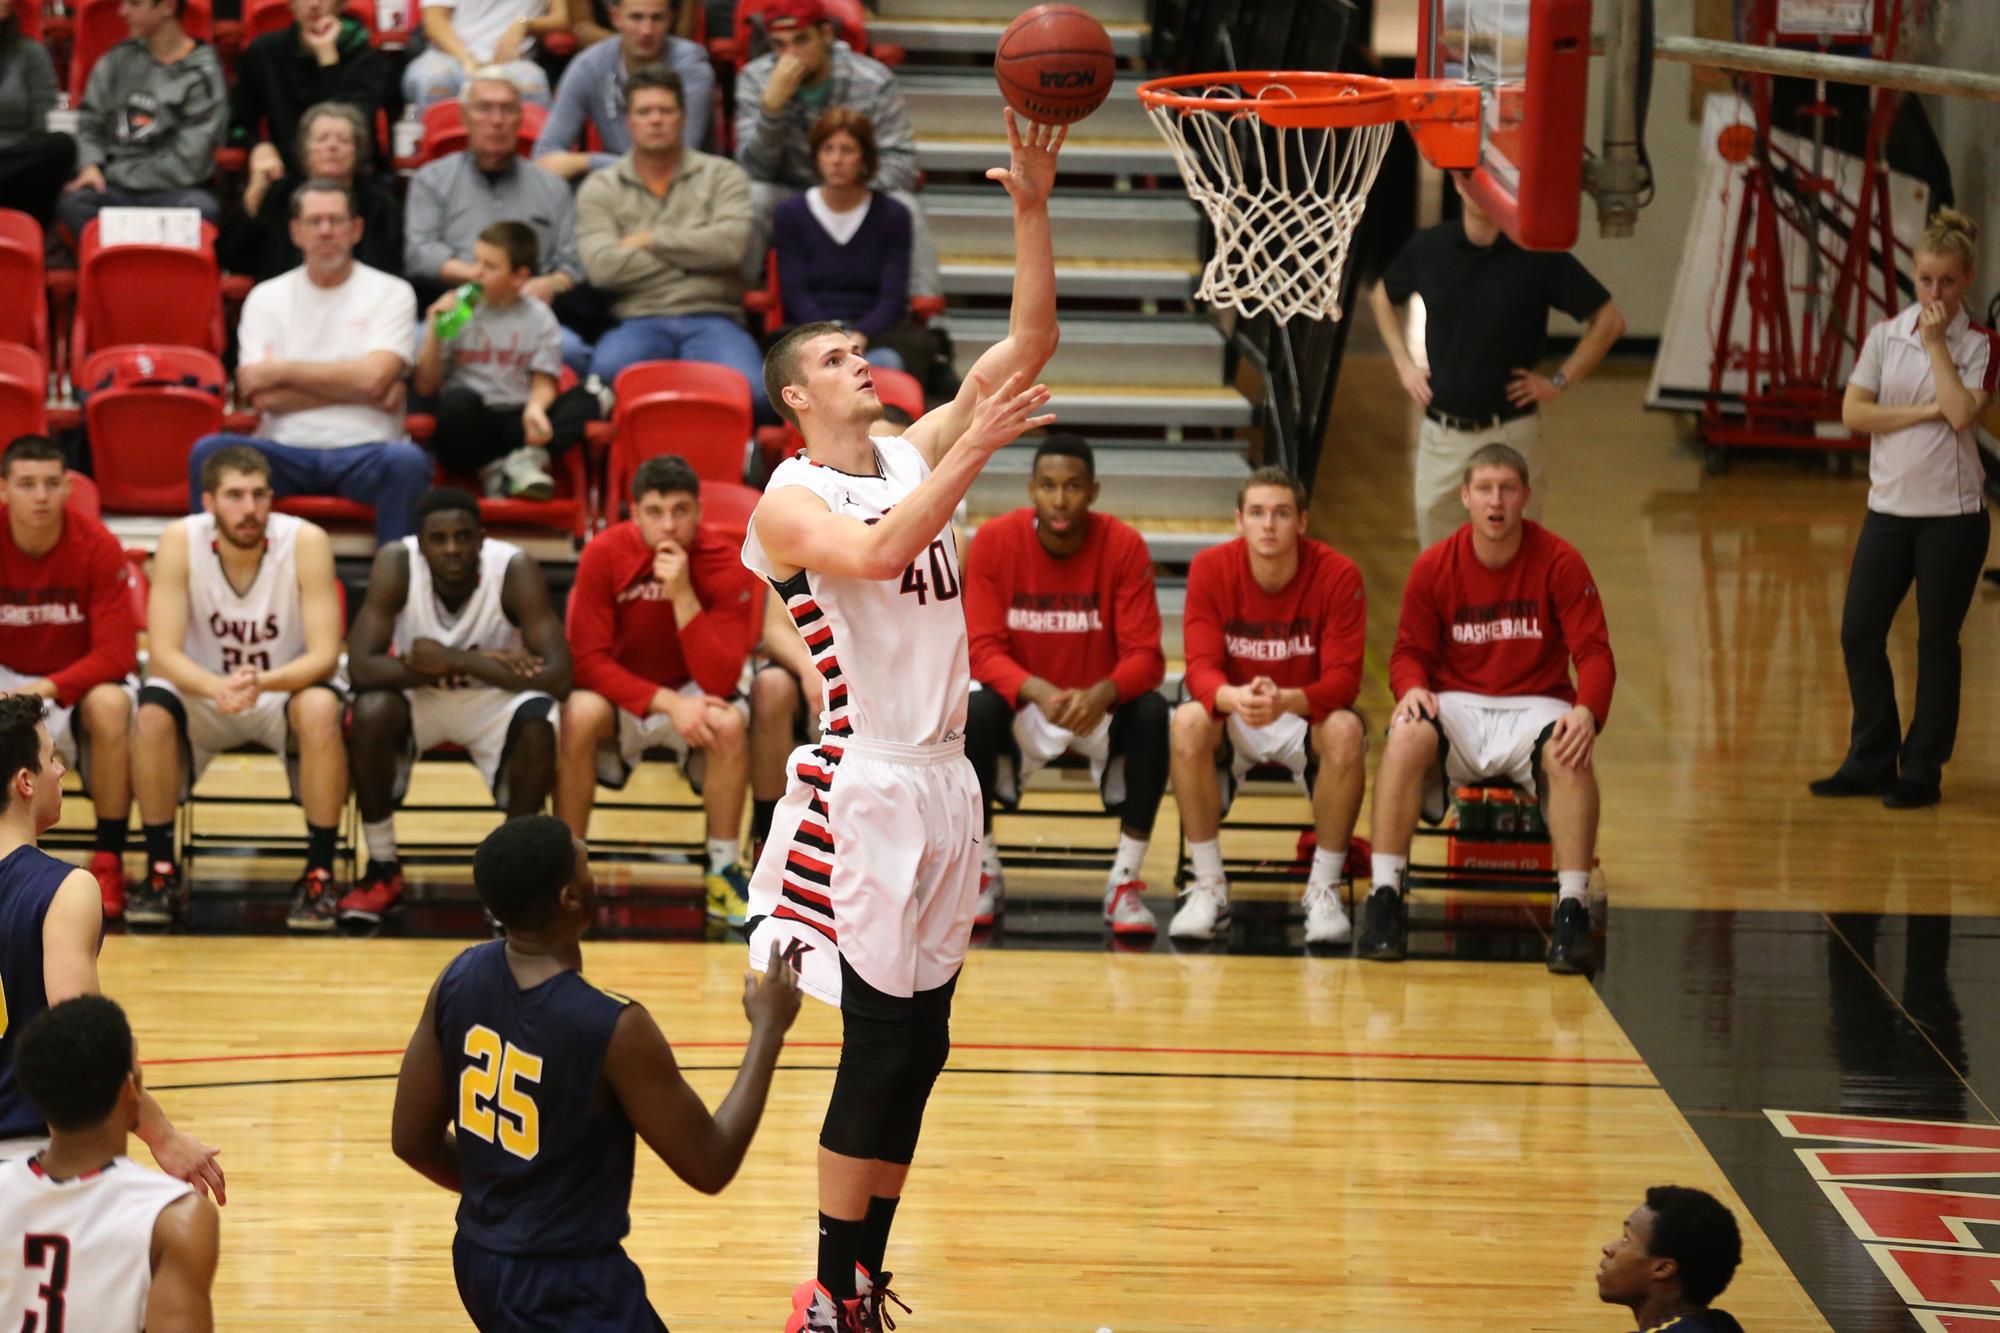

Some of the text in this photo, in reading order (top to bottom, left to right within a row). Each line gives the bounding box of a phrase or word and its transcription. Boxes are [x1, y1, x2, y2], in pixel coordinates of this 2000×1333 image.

[1039, 67, 1096, 88] NCAA
[900, 539, 959, 605] 40
[1452, 617, 1543, 645] BASKEBALL
[782, 935, 816, 975] K
[459, 1023, 544, 1162] 25
[19, 1232, 71, 1333] 3
